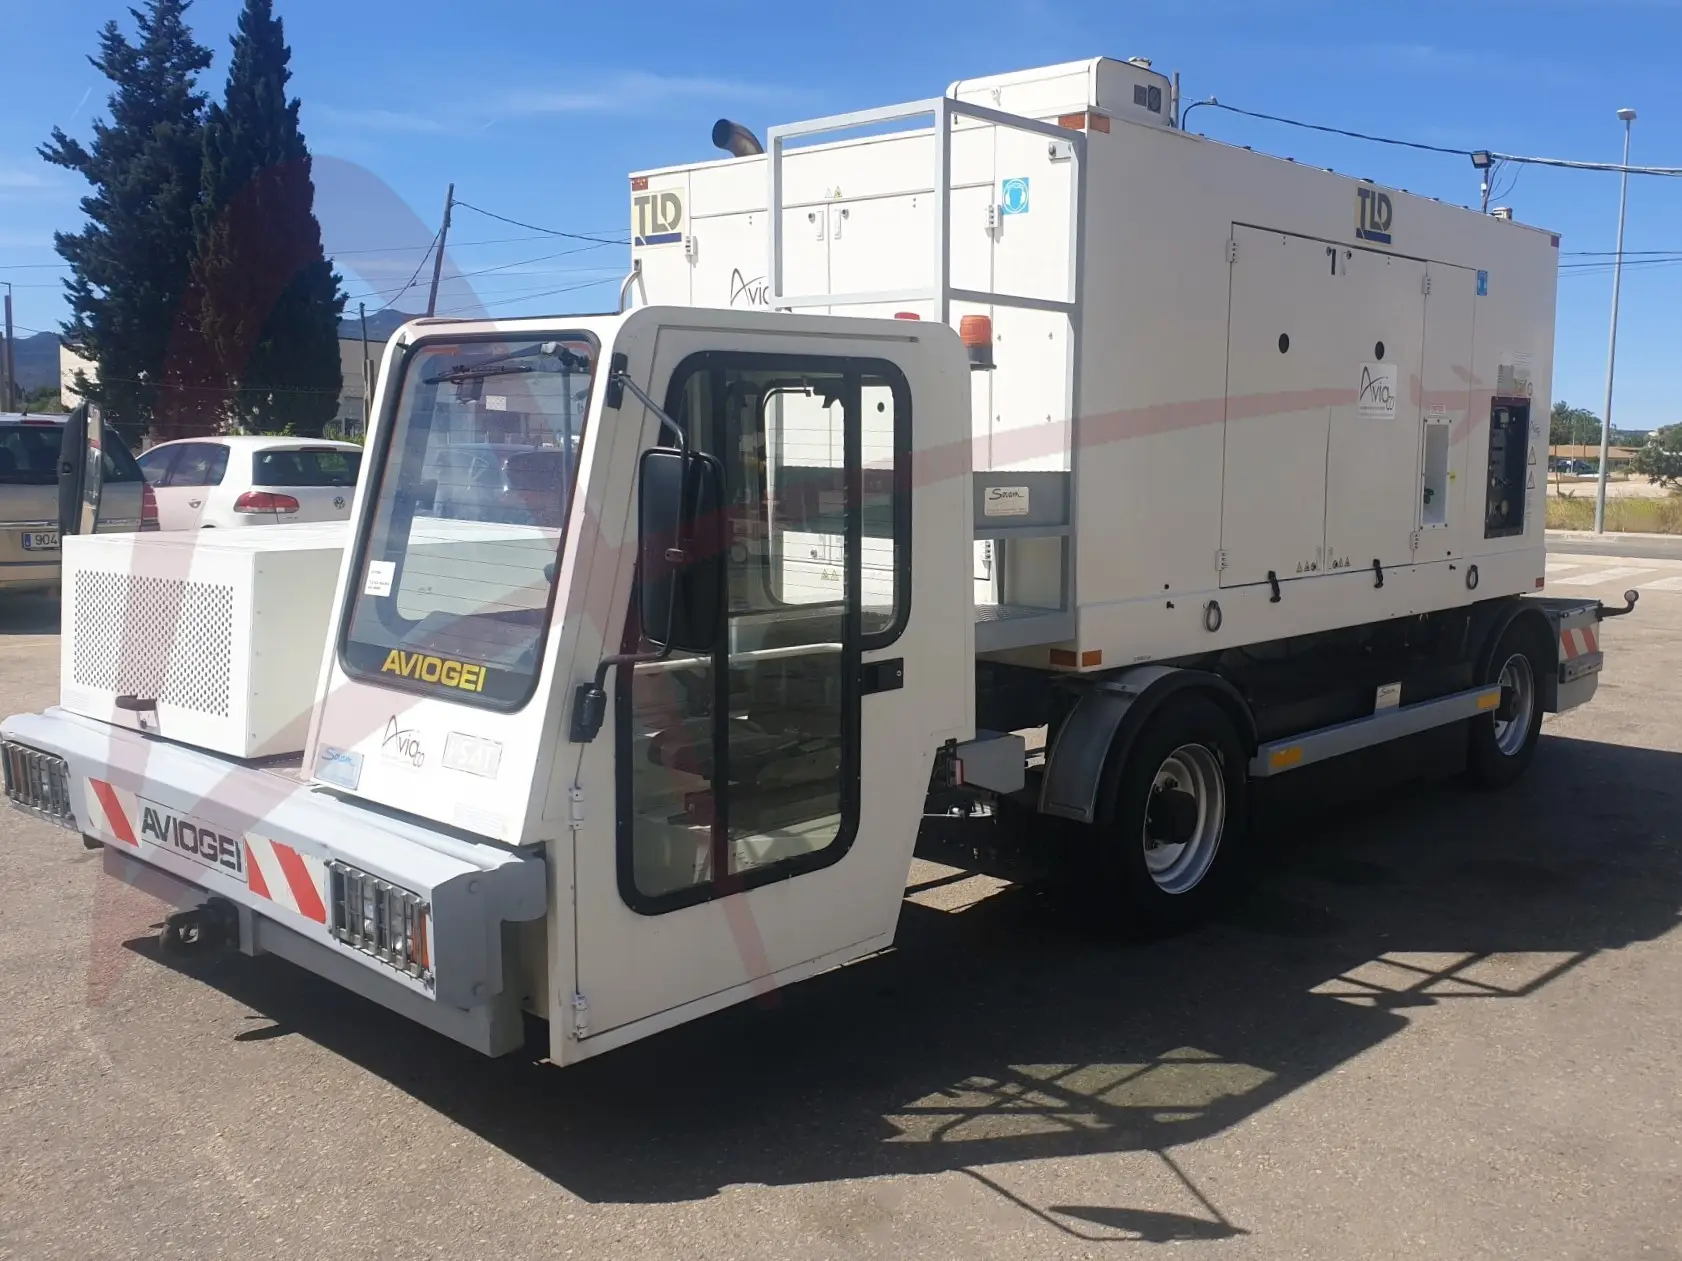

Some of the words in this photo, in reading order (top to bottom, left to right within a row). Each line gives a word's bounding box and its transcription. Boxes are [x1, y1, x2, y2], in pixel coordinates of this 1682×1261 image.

[634, 192, 682, 240] TLD
[1357, 187, 1392, 232] TLD
[380, 649, 486, 692] AVIOGEI
[141, 806, 242, 873] AVIOGEI
